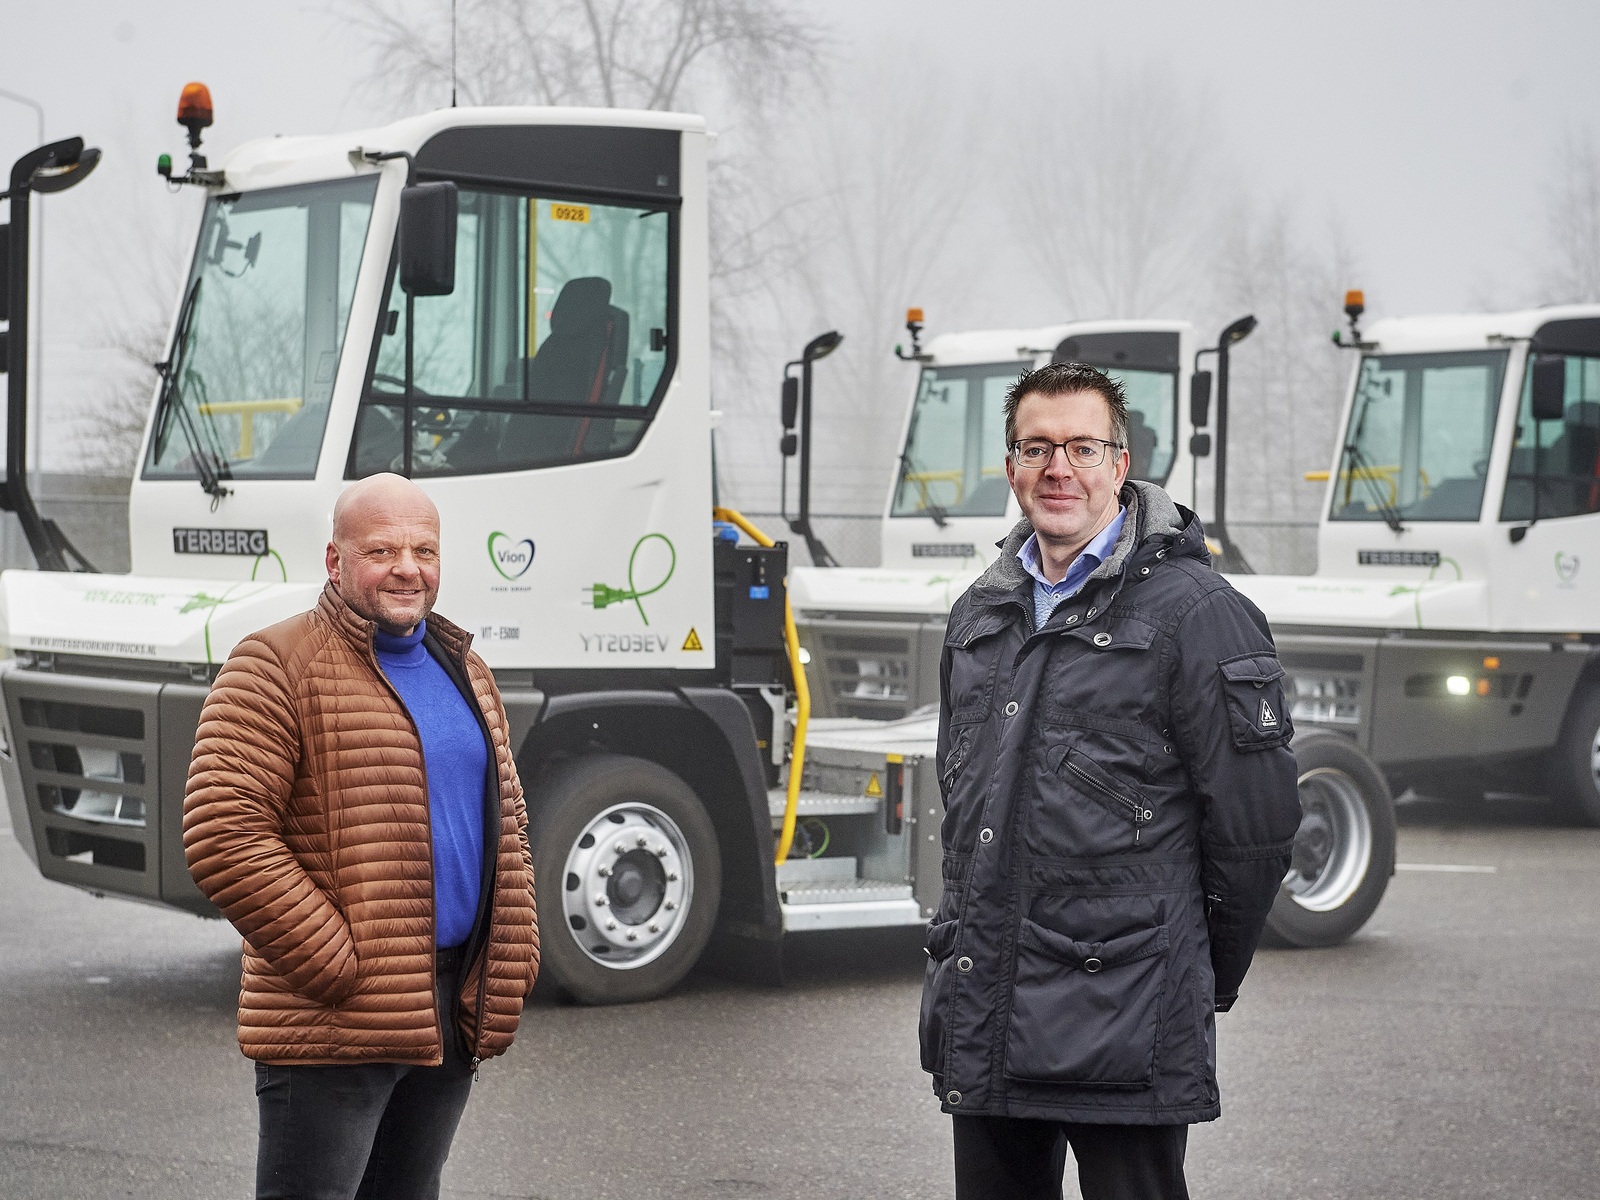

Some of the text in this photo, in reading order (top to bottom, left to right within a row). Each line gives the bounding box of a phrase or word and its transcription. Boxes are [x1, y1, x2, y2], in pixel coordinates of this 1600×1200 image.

[556, 208, 584, 221] 0928
[174, 529, 265, 554] TERBERG
[498, 550, 526, 563] Vion
[579, 632, 668, 652] YT203EV
